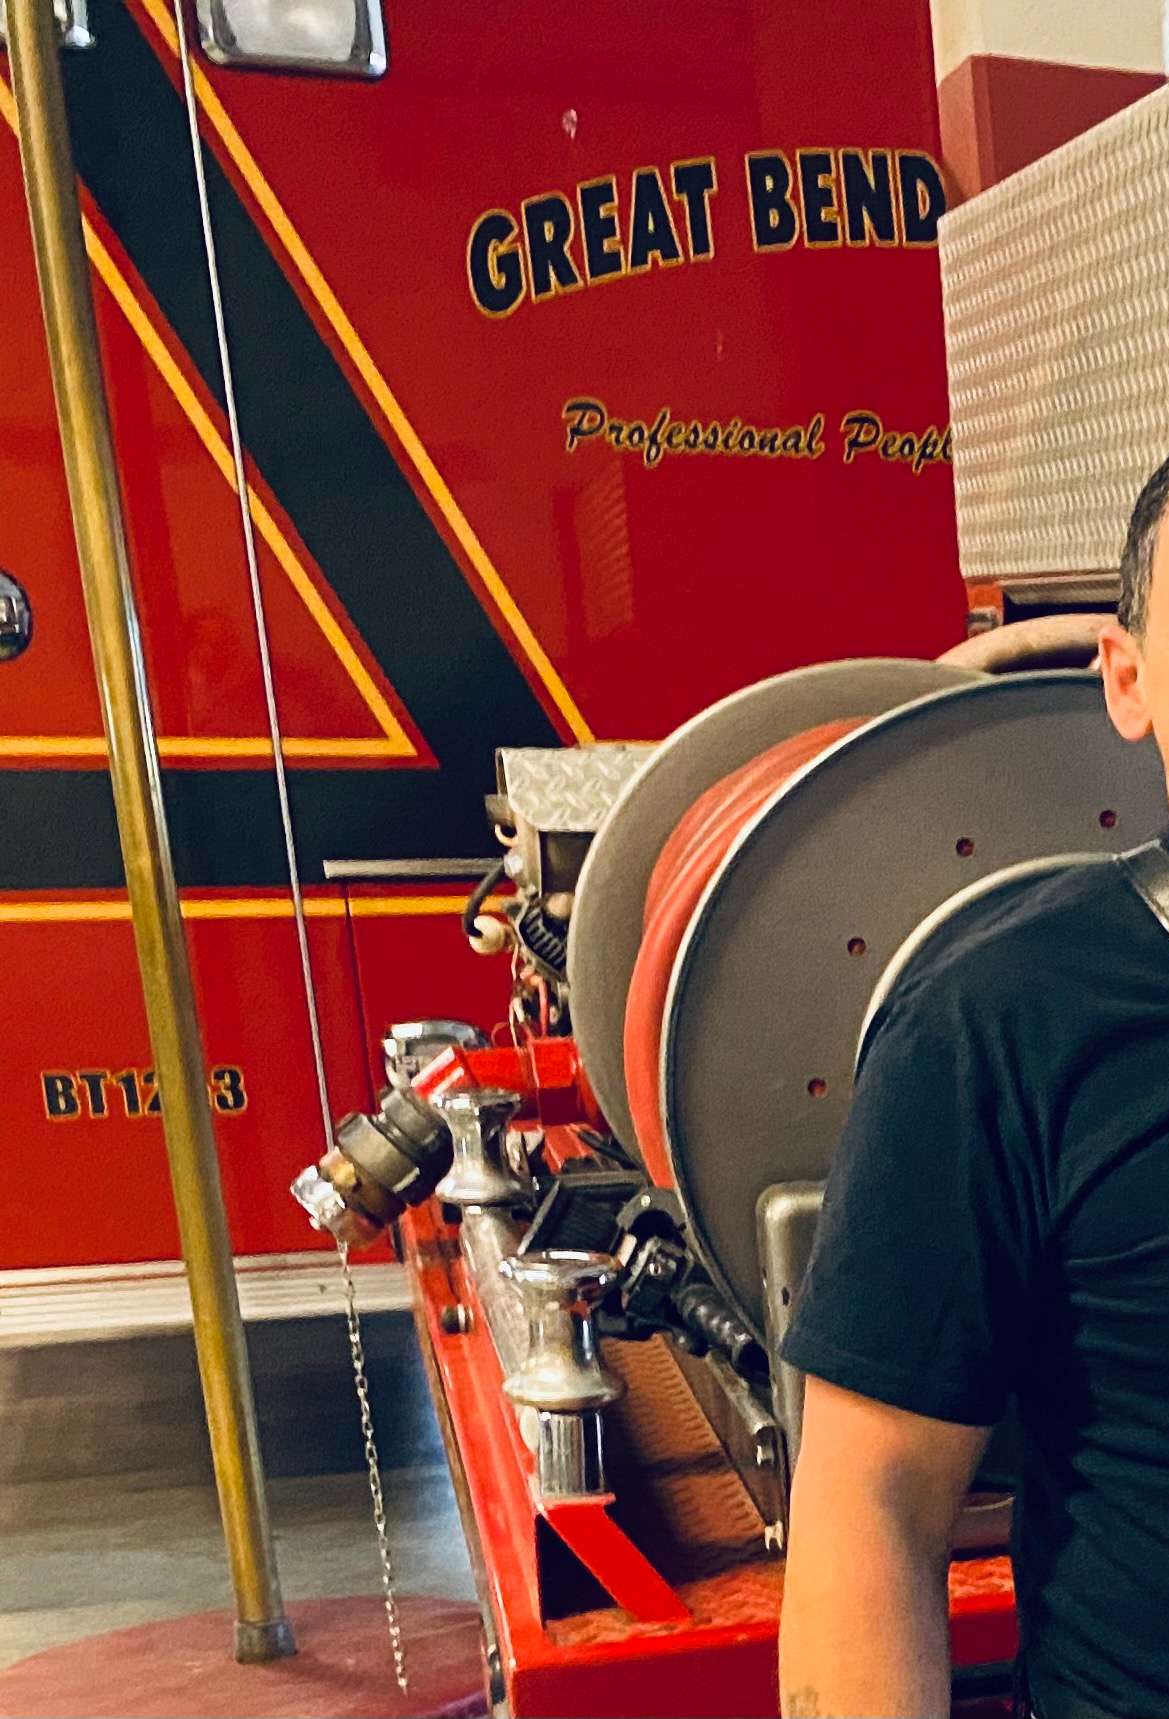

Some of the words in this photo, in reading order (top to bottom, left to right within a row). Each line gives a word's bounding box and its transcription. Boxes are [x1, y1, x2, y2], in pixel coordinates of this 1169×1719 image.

[467, 155, 718, 319] GREAT
[744, 147, 946, 252] BEND
[563, 396, 824, 469] Professional
[41, 1066, 248, 1120] BT123
